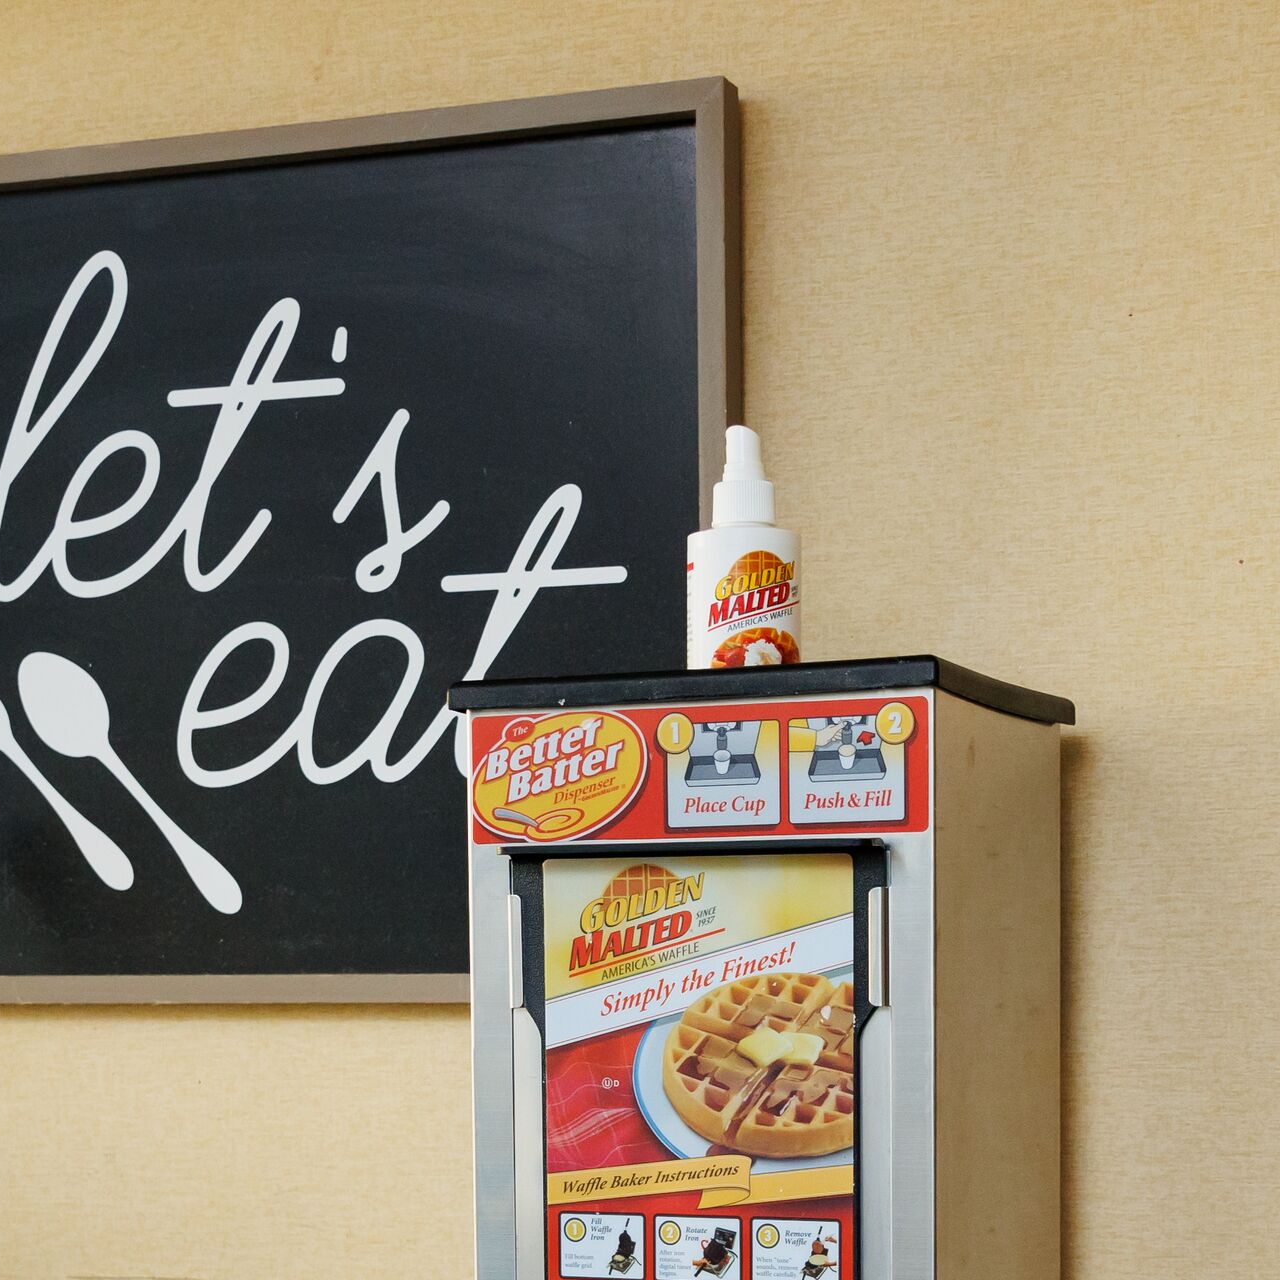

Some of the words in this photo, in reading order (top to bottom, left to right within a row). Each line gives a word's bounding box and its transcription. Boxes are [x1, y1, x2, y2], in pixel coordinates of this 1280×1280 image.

[714, 560, 796, 602] GOLDEN
[708, 582, 791, 628] MALTED
[727, 613, 769, 632] AMERICA'S
[769, 607, 793, 621] WAFFLE
[177, 484, 628, 788] eat
[512, 725, 529, 737] The
[670, 721, 681, 745] 1
[887, 711, 902, 735] 2
[484, 716, 604, 782] Better
[507, 740, 624, 803] Batter
[553, 775, 616, 805] Dispenser
[803, 792, 845, 810] Push
[863, 789, 892, 808] Fill
[683, 796, 727, 814] Place
[731, 795, 766, 816] Cup
[580, 871, 705, 934] GOLDEN
[695, 905, 717, 920] SINCE
[697, 915, 715, 928] 1937
[569, 910, 692, 971] MALTED
[601, 956, 656, 981] AMERICA'S
[658, 941, 699, 963] WAFFLE
[600, 978, 675, 1017] Simply
[681, 969, 713, 994] the
[720, 942, 797, 983] Finest!
[562, 1177, 608, 1195] Waffle
[610, 1174, 652, 1189] Baker
[654, 1163, 740, 1185] Instructions
[591, 1217, 602, 1225] Fill
[591, 1226, 613, 1235] Waffle
[666, 1227, 674, 1239] 2
[685, 1226, 707, 1234] Rotate
[685, 1234, 699, 1242] Iron
[764, 1229, 772, 1242] 3
[784, 1230, 812, 1238] Remove
[784, 1238, 807, 1247] Waffle
